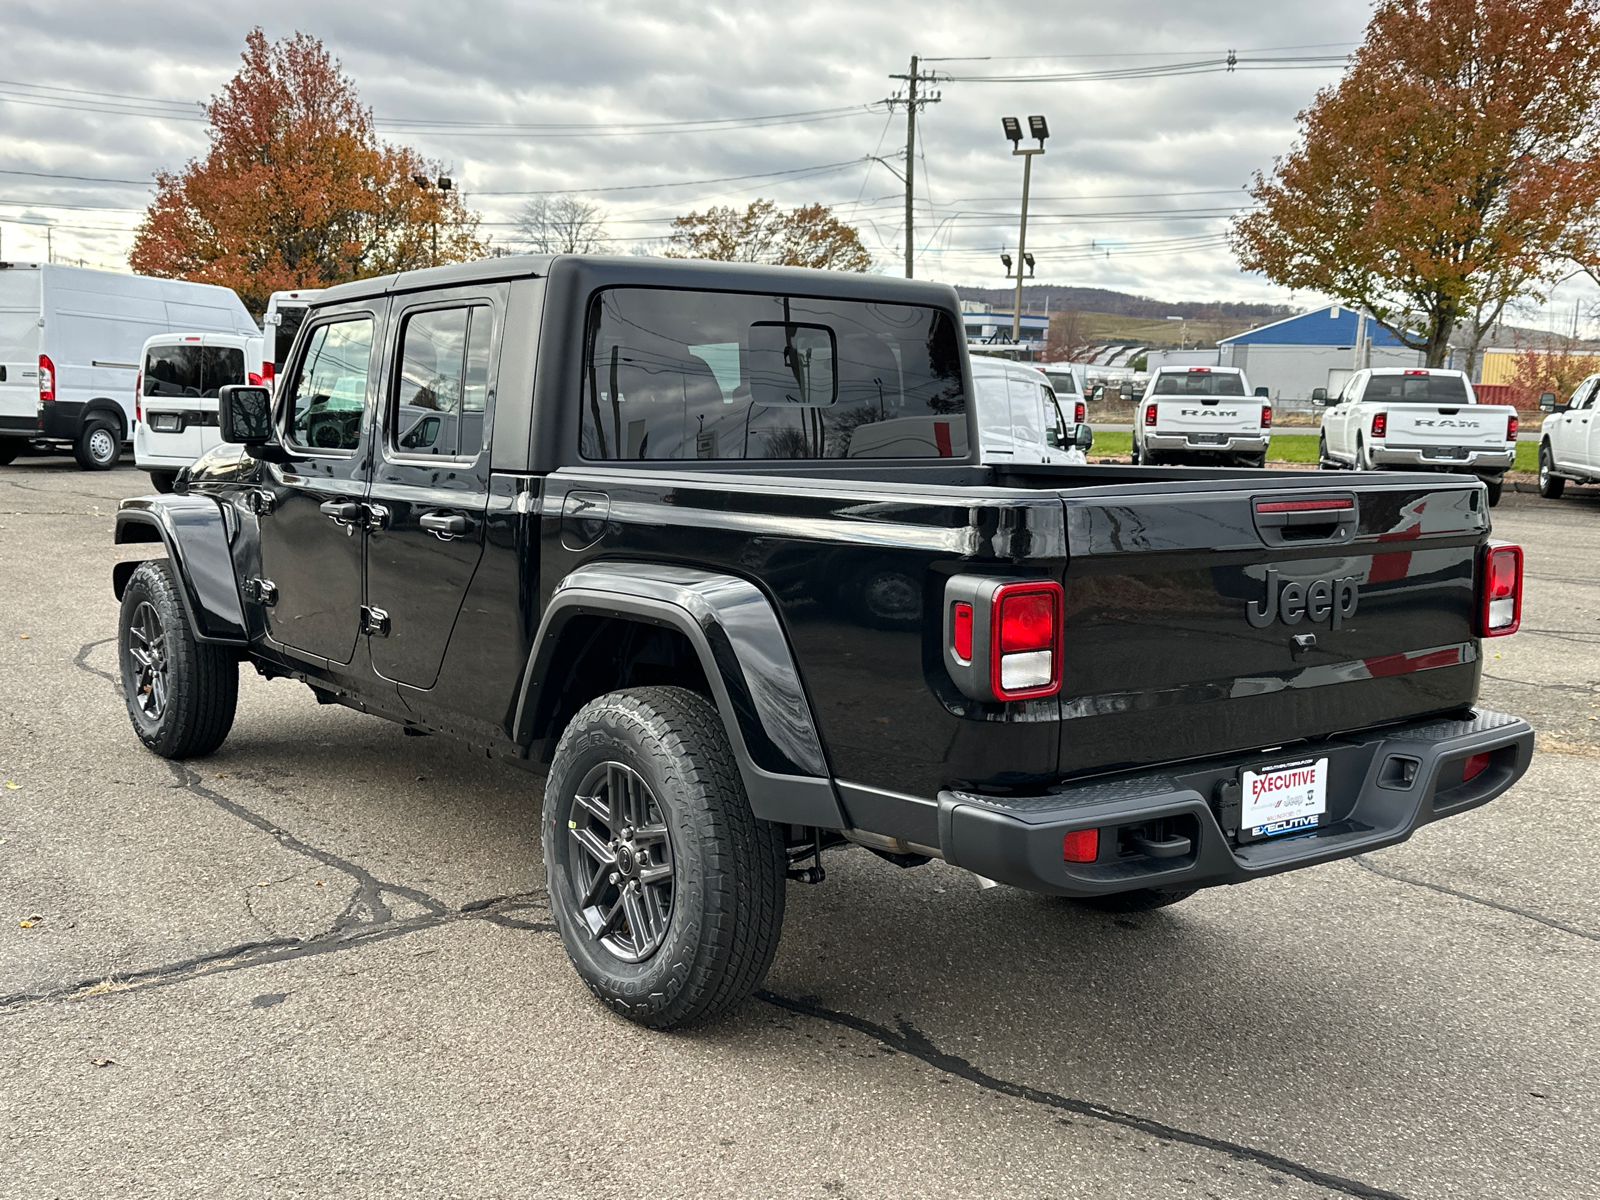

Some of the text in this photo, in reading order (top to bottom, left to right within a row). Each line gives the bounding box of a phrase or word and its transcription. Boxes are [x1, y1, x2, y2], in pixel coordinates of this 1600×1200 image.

[1181, 409, 1237, 417] RAM
[1415, 419, 1480, 428] RAM
[1246, 569, 1358, 631] Jeep
[1252, 769, 1316, 804] EXECUTIVE
[1284, 795, 1303, 807] Jeep
[1252, 815, 1318, 837] EXECUTIVE
